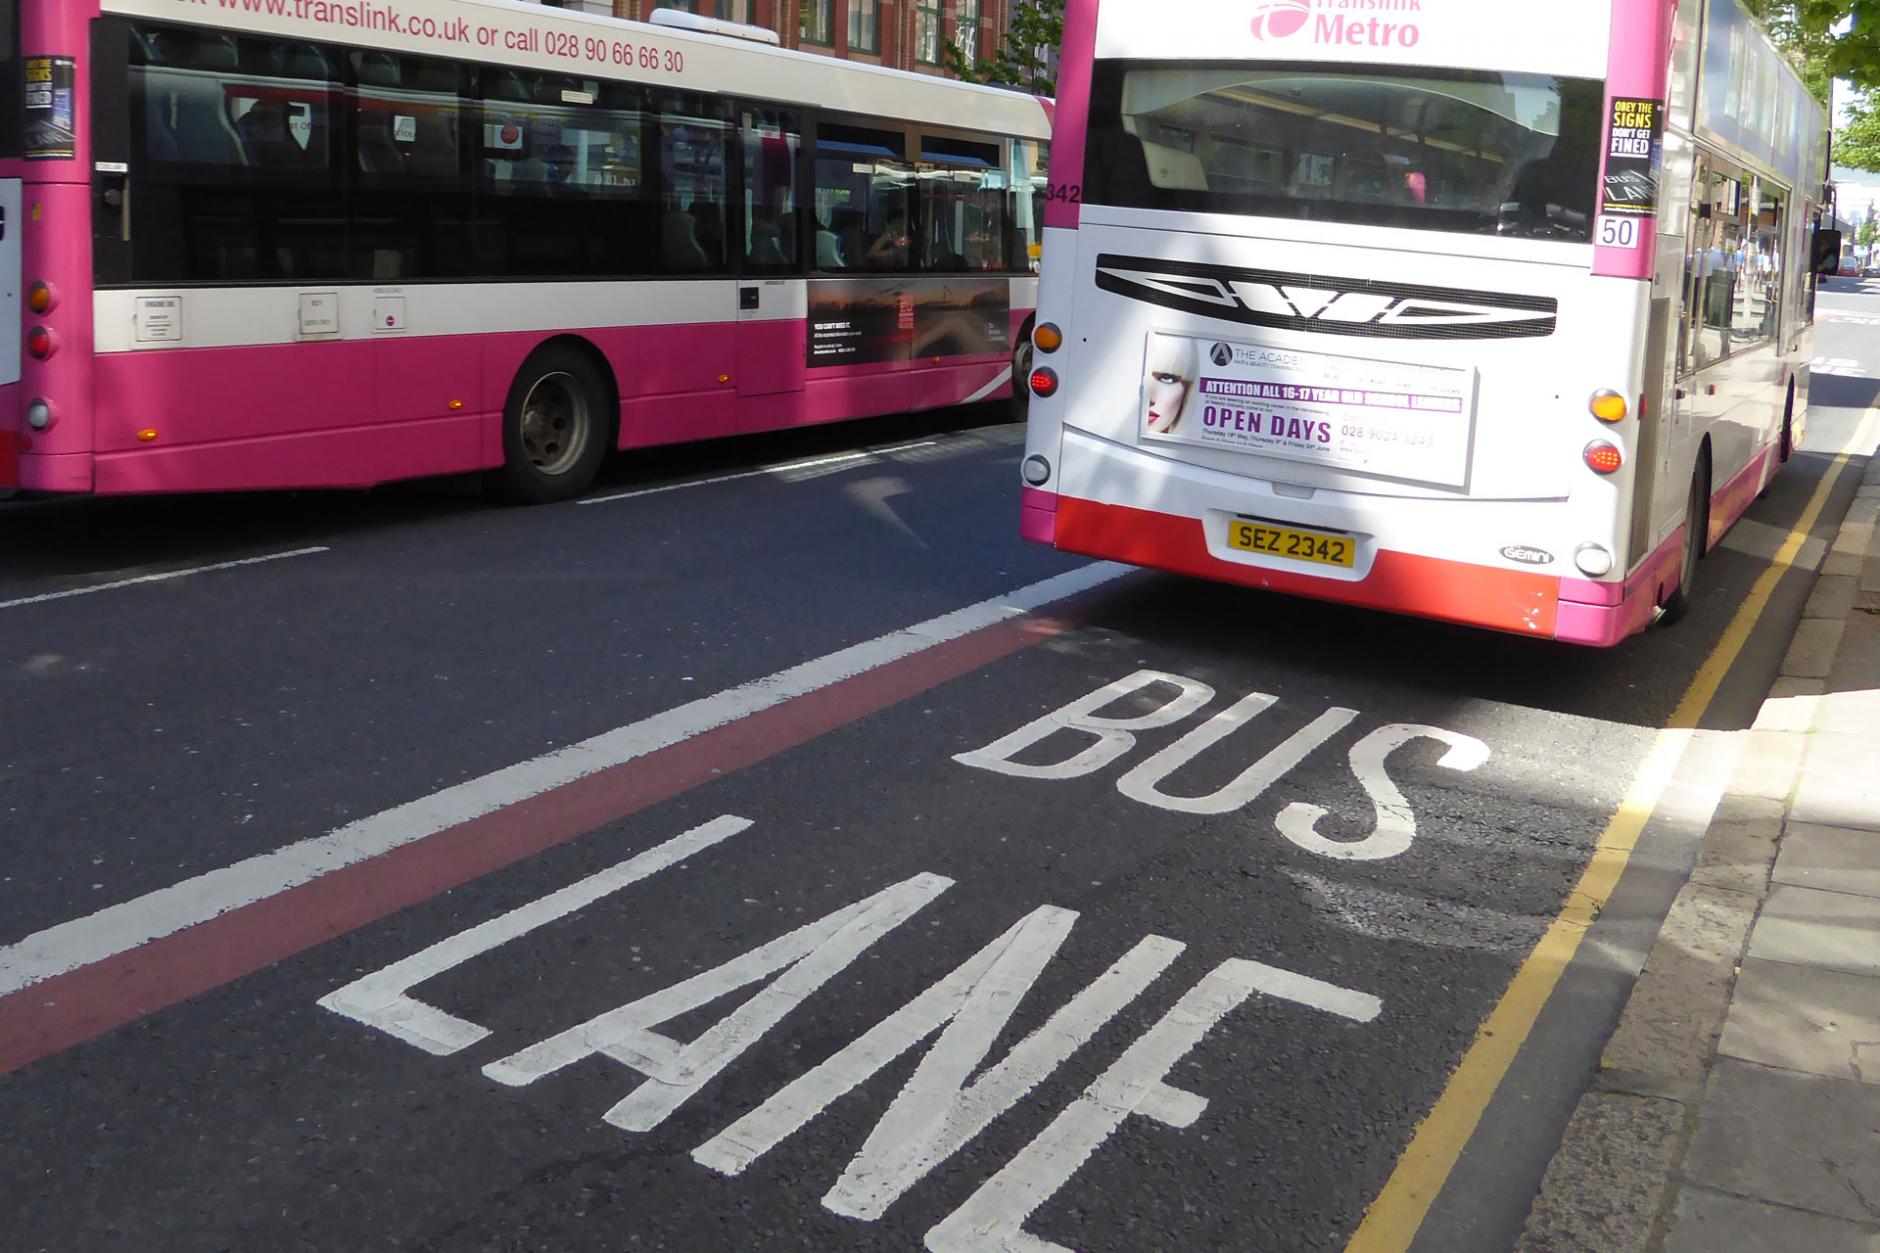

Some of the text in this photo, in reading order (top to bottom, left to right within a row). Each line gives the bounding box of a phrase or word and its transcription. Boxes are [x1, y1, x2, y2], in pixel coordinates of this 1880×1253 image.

[1314, 13, 1419, 48] Metro
[477, 26, 498, 46] or
[504, 28, 539, 52] call
[545, 31, 579, 58] 028
[585, 37, 606, 62] 90
[612, 42, 633, 66] 66
[638, 46, 659, 70] 66
[664, 50, 684, 73] 30
[1615, 101, 1653, 115] OBEY THE
[1613, 112, 1652, 128] SIGNS
[1612, 127, 1651, 139] DON'T GET
[1611, 137, 1649, 154] FINED
[1604, 175, 1640, 184] BUS
[1602, 219, 1632, 246] 50
[1235, 348, 1256, 360] THE
[1205, 381, 1261, 396] ATTENTION
[1262, 385, 1280, 397] ALL
[1282, 386, 1311, 400] 16-17
[1203, 405, 1262, 433] OPEN
[1270, 415, 1331, 443] DAYS
[1341, 425, 1364, 439] 028
[1240, 526, 1345, 563] SEZ 2342
[1503, 546, 1550, 563] GEMINI
[952, 669, 1490, 861] BUS
[316, 813, 1383, 1253] LANE
